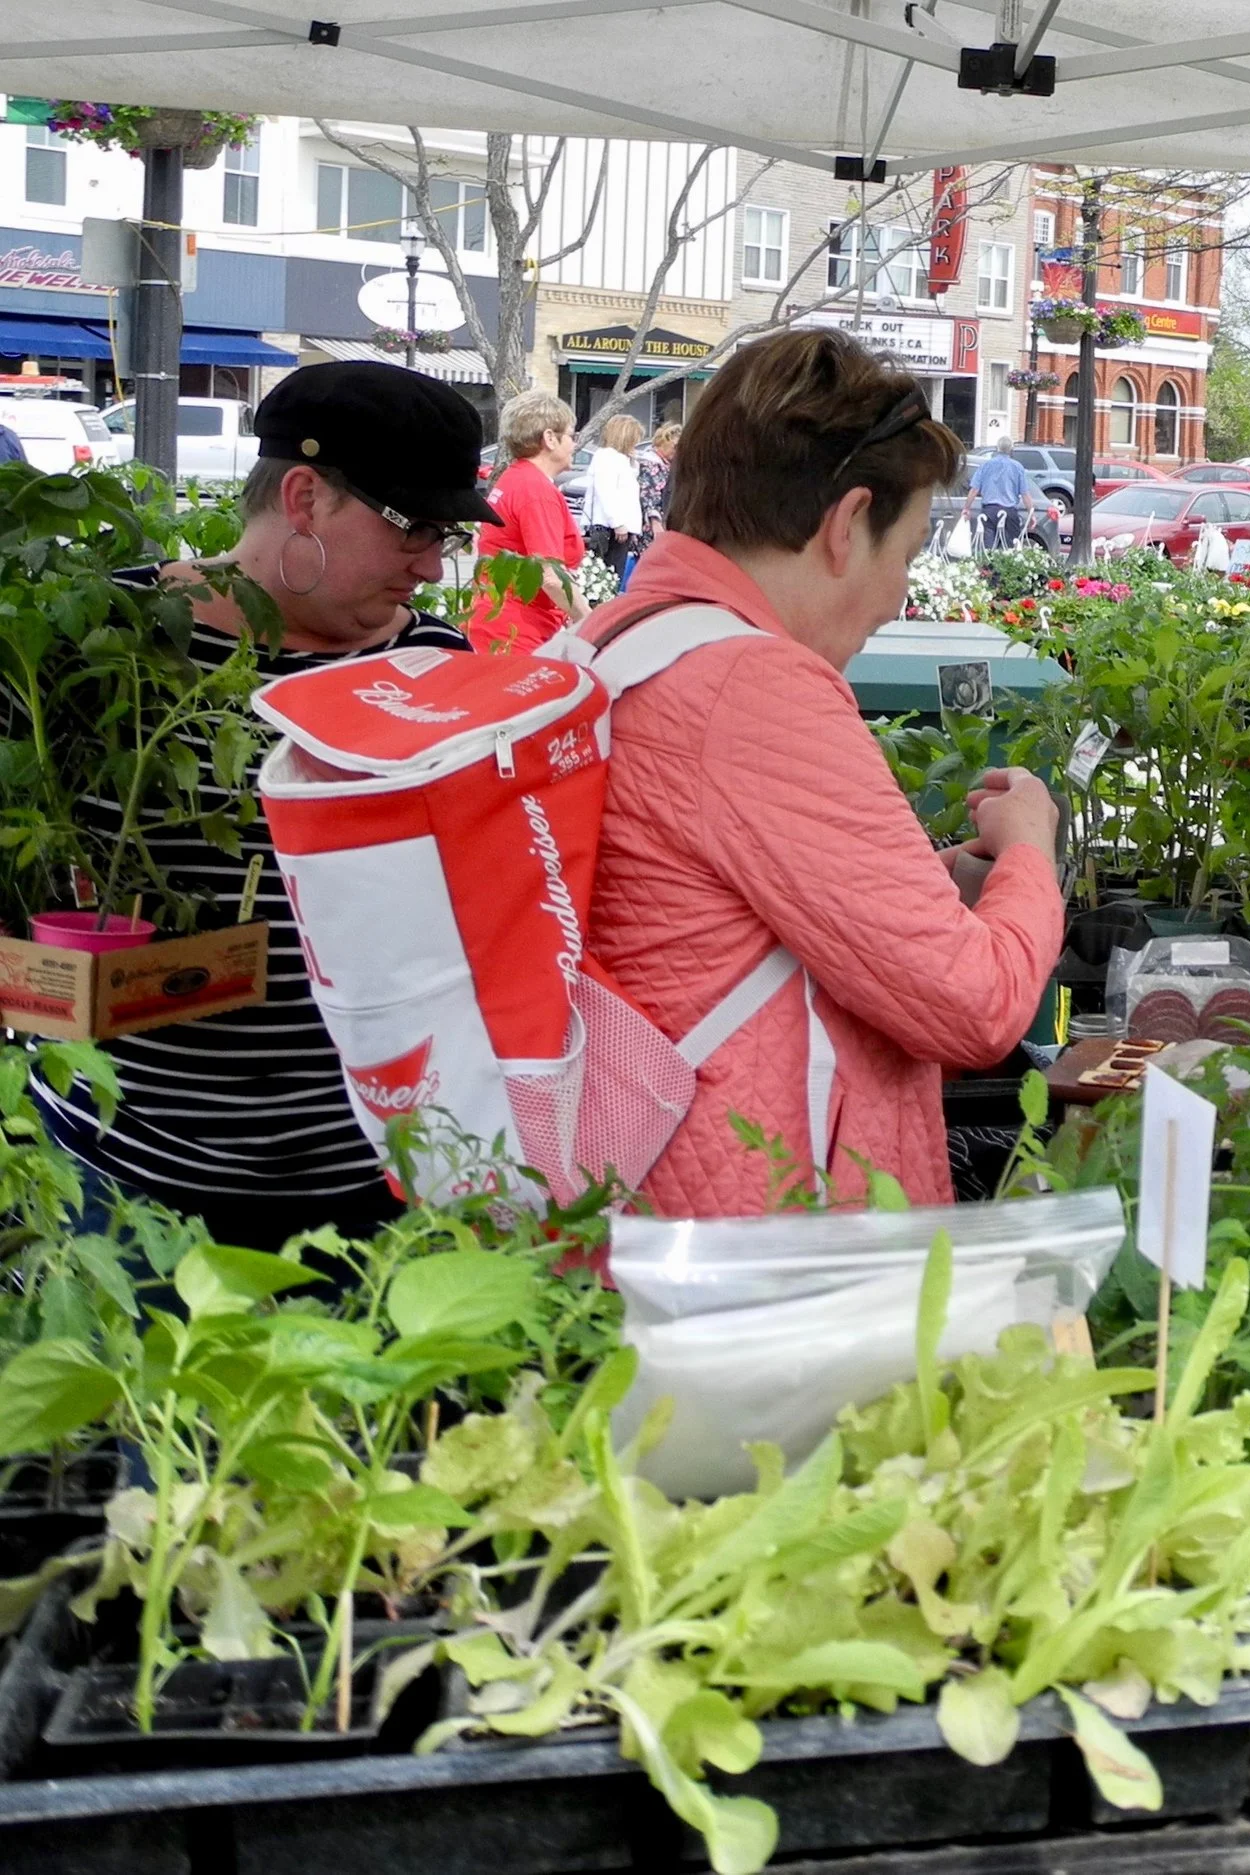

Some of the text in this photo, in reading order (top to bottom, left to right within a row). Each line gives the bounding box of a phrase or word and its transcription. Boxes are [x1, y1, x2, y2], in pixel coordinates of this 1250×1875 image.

[838, 318, 904, 333] CHCK OUT
[1151, 313, 1177, 330] Centre
[566, 334, 710, 357] ALL AROUN THE HOUSE
[957, 323, 978, 369] P
[548, 729, 577, 766] 24
[558, 750, 580, 774] 355
[521, 794, 582, 986] Budweiser
